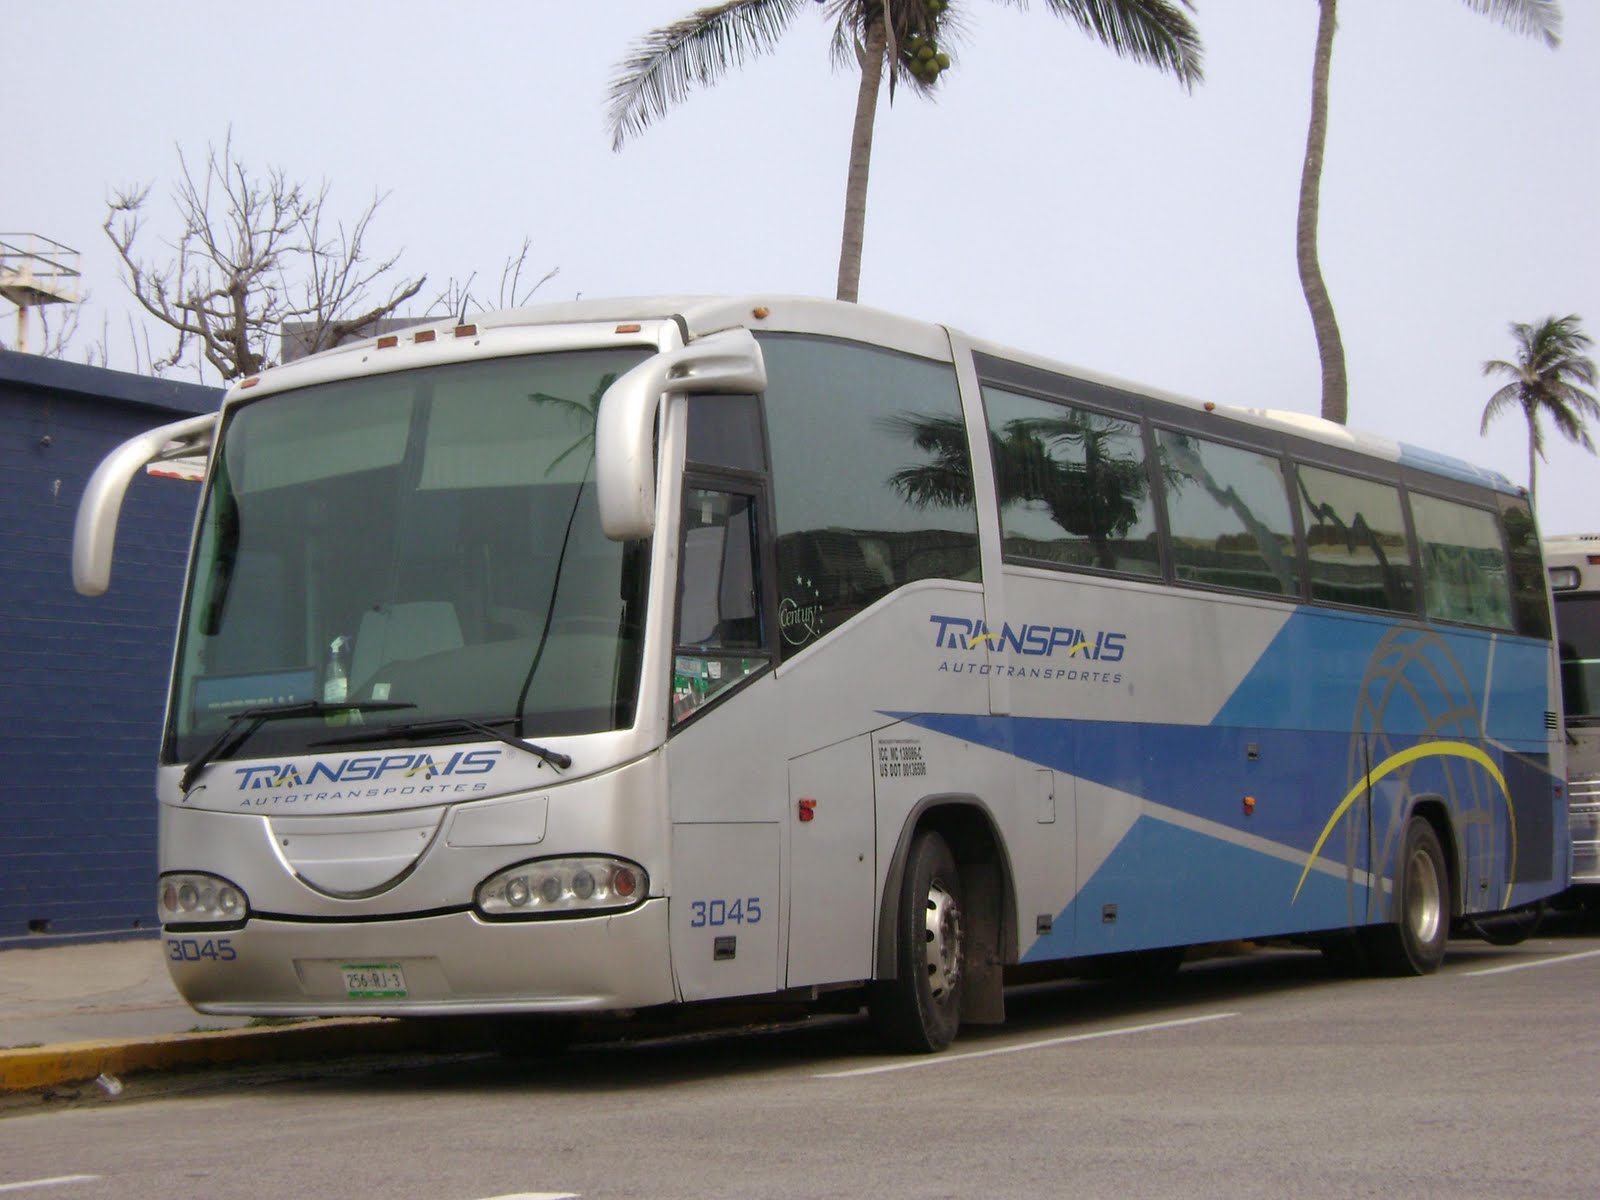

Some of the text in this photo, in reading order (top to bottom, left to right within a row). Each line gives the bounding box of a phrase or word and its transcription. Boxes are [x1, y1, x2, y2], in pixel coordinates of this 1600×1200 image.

[780, 605, 817, 627] Century
[929, 615, 1127, 662] TRANSPAIS
[938, 662, 1122, 684] AUTOTRANSPORTES
[234, 750, 502, 790] TRANSPAIS
[880, 763, 888, 777] US
[890, 763, 901, 777] DOT
[240, 782, 487, 807] AUTOTRANSPORTES
[691, 897, 762, 928] 3045
[167, 939, 237, 961] 3045
